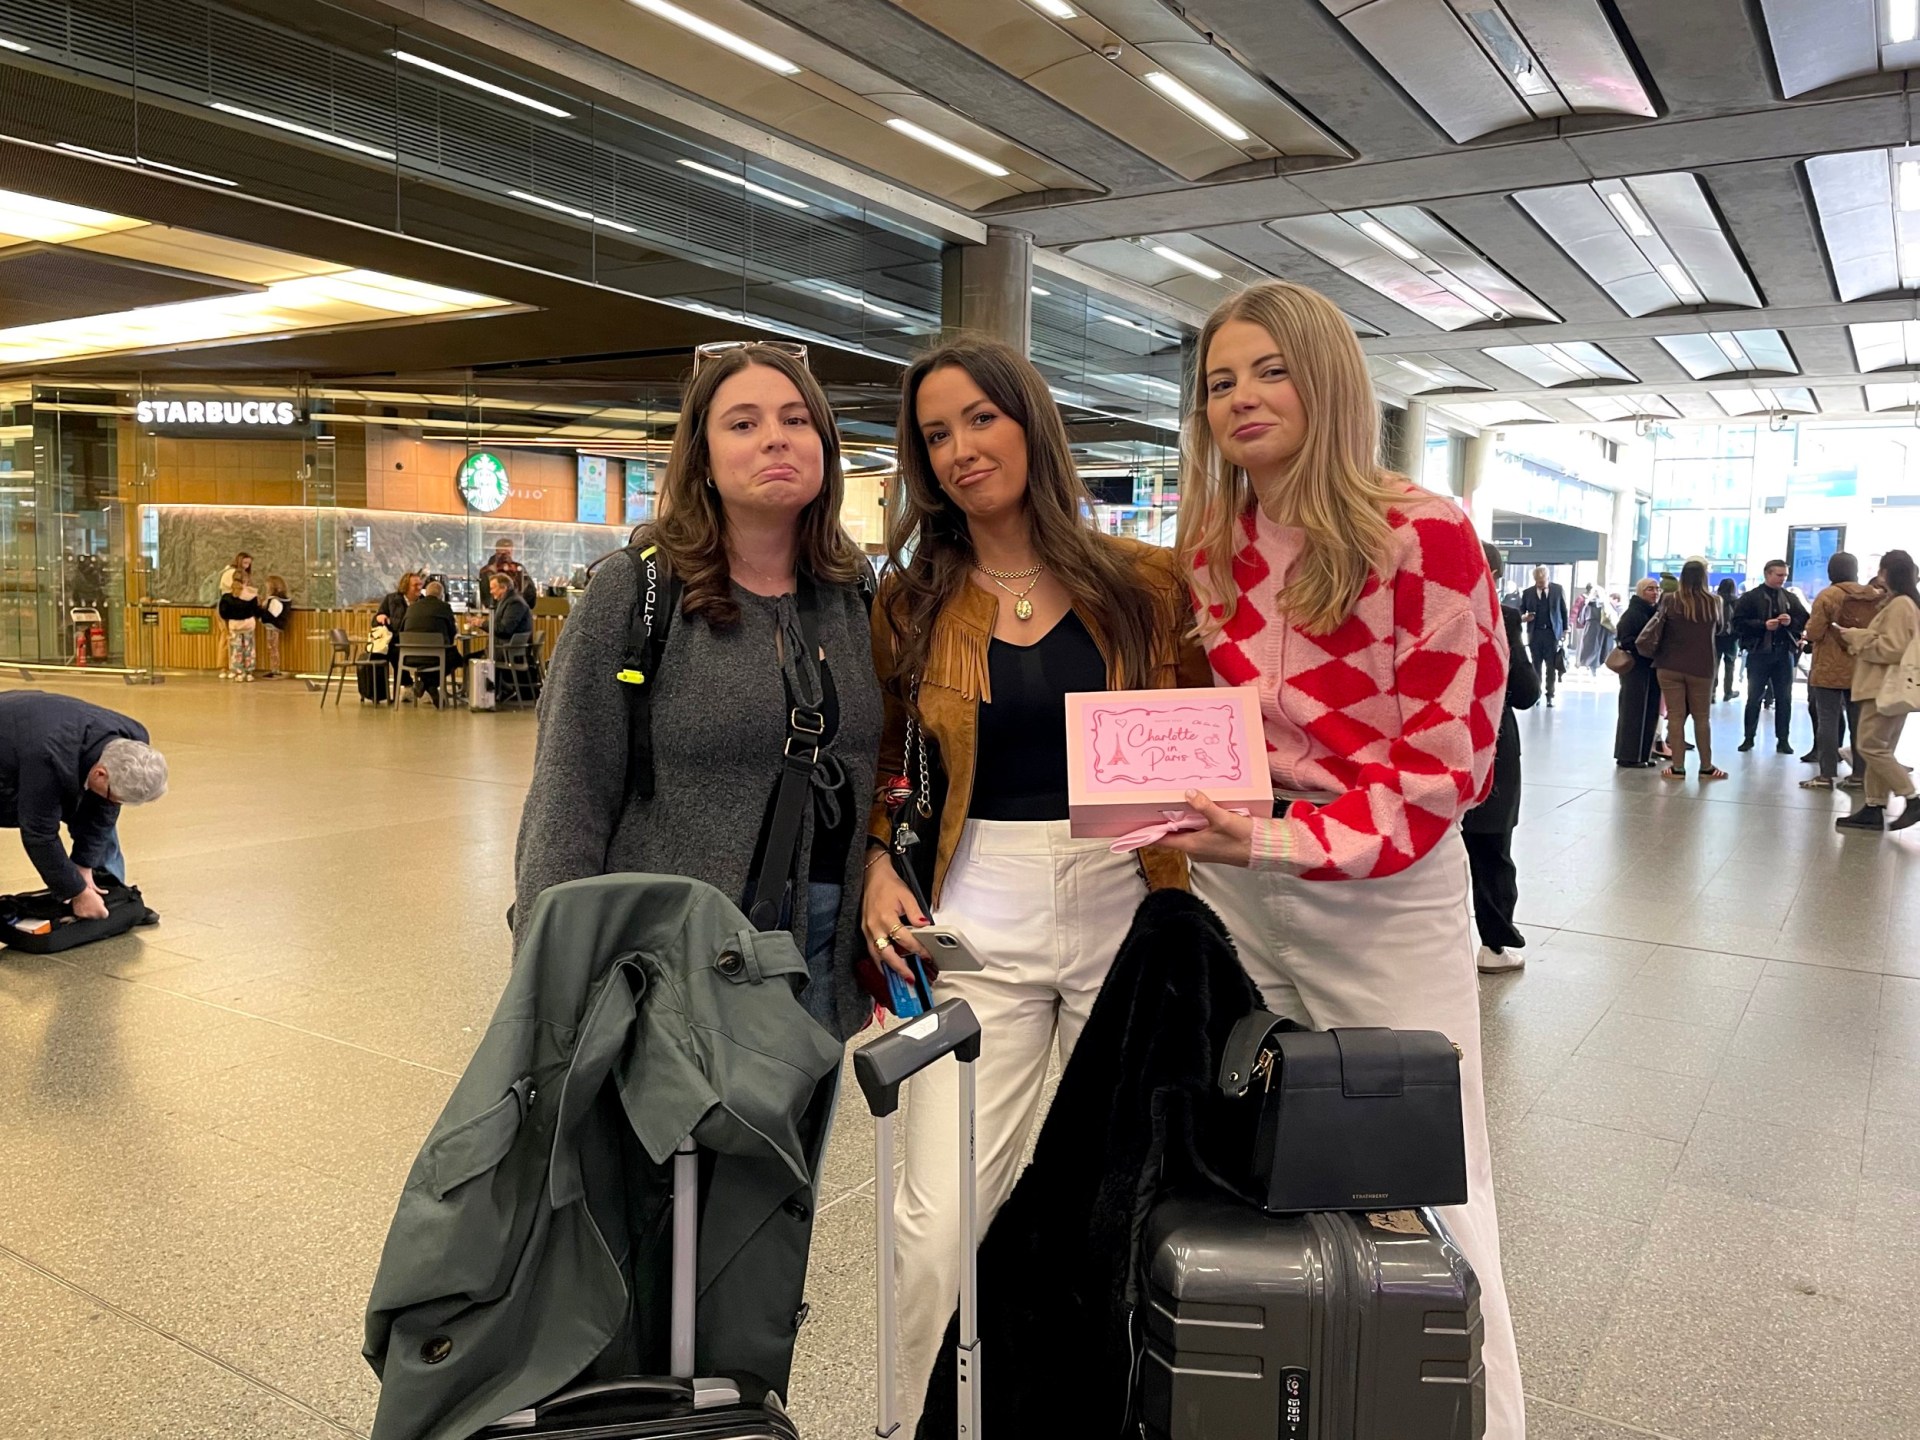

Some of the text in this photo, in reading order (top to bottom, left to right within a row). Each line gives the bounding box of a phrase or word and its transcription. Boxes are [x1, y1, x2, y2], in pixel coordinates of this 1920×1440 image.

[136, 400, 294, 425] STARBUCKS
[1127, 723, 1199, 748] Charlotte
[1167, 741, 1178, 752] in
[1141, 745, 1189, 772] Paris
